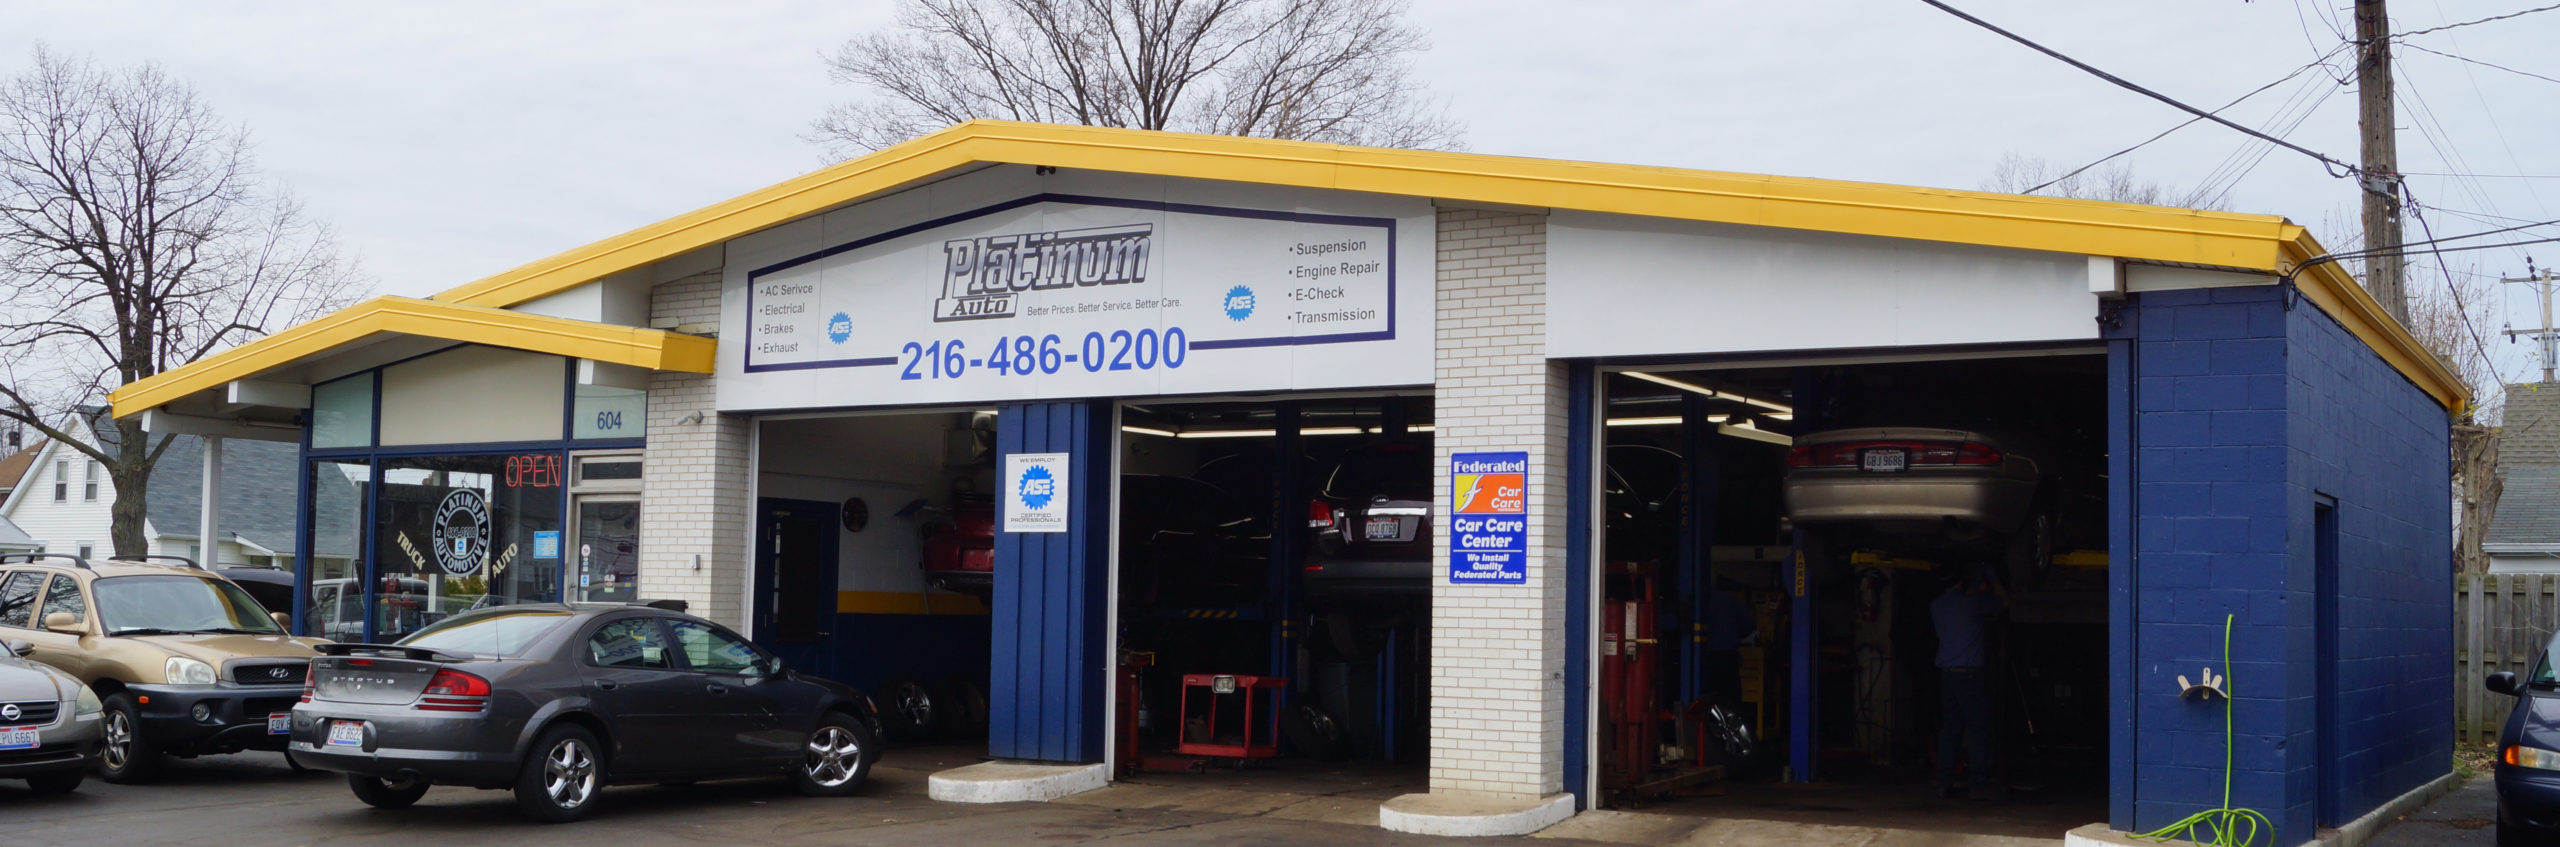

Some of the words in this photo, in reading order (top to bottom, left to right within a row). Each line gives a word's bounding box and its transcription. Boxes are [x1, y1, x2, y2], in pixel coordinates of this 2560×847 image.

[1296, 239, 1366, 256] Suspension
[942, 226, 1153, 297] Platinum
[1296, 264, 1337, 280] Engine
[1340, 260, 1380, 277] Repair
[765, 285, 778, 296] AC
[781, 284, 814, 296] Serivce
[1296, 286, 1345, 301] E-Check
[765, 302, 806, 316] Electrical
[950, 296, 1010, 317] Auto
[1027, 306, 1050, 316] Better
[1051, 304, 1076, 315] Prices.
[1078, 302, 1101, 313] Better
[1102, 300, 1132, 312] Service.
[1135, 298, 1160, 310] Better
[1161, 297, 1182, 308] Care.
[1227, 296, 1251, 310] ASE
[1295, 308, 1376, 324] Transmission
[764, 324, 794, 334] Brakes
[830, 321, 850, 334] ASE
[763, 342, 799, 354] Exhaust
[900, 326, 1187, 381] 216-486-0200
[597, 410, 622, 430] 604
[506, 456, 562, 488] OPEN
[1454, 460, 1524, 473] Federated
[1022, 478, 1051, 496] ASE
[1498, 486, 1522, 497] Car
[438, 493, 487, 526] PLATINUM
[1491, 498, 1521, 508] Care
[1454, 518, 1484, 533] Car
[1486, 518, 1524, 532] Care
[1462, 534, 1513, 548] Center
[397, 530, 426, 570] TRUCK
[436, 537, 487, 572] AUTOMOTIVE
[492, 543, 518, 578] AUTO
[1467, 554, 1480, 562] We
[1482, 554, 1510, 562] Install
[1454, 570, 1497, 579] Federated
[1498, 571, 1522, 579] Parts
[1472, 562, 1503, 572] Quality
